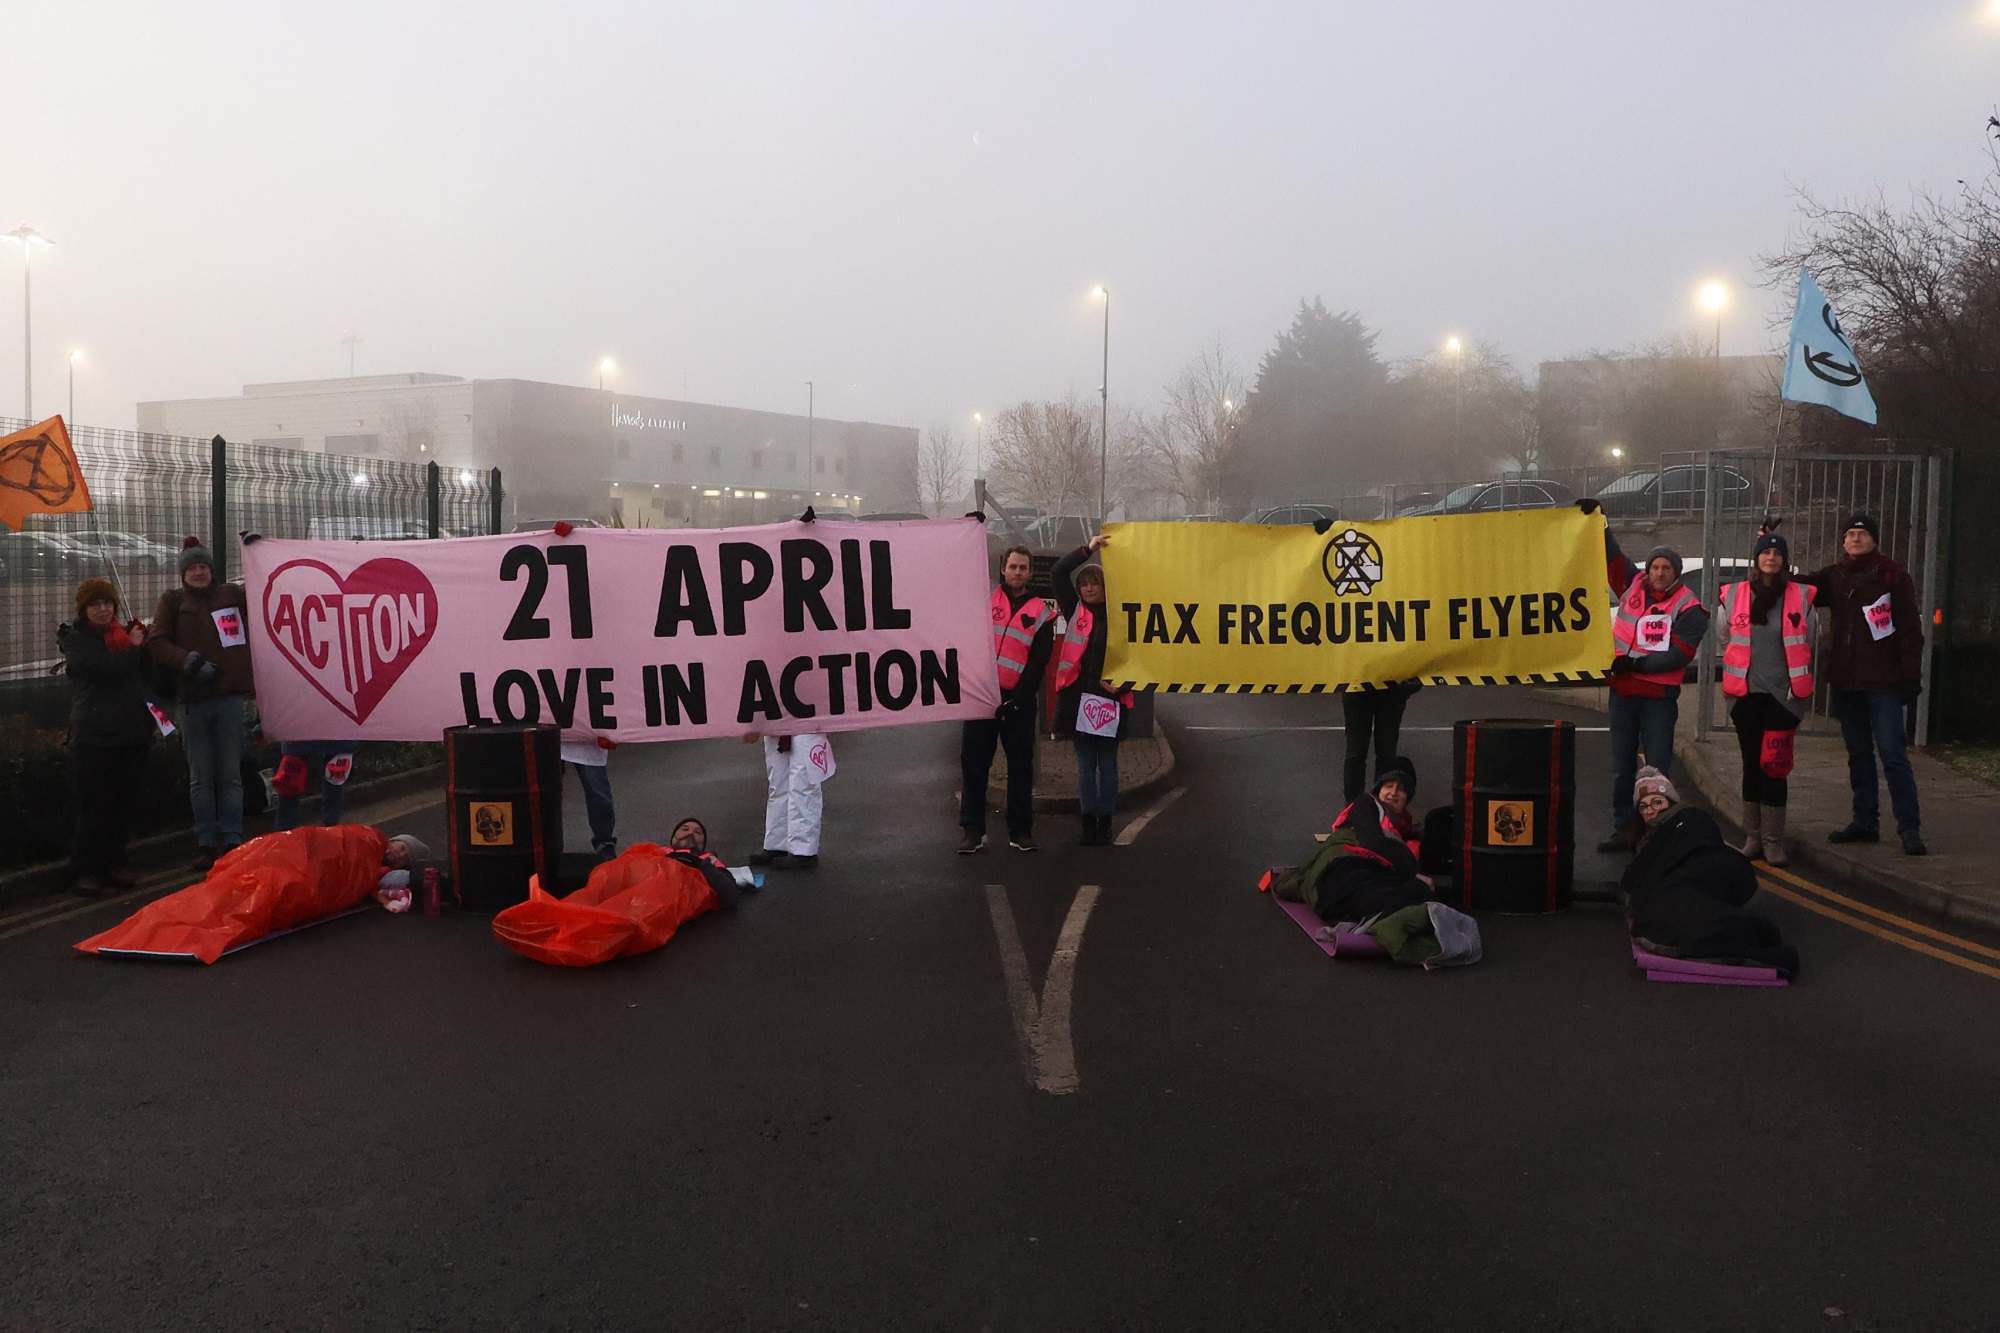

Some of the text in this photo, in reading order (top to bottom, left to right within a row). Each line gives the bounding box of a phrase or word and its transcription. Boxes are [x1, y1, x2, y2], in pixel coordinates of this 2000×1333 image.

[500, 539, 911, 640] 21 APRIL
[1122, 587, 1591, 646] TAX FREQUENT FLYERS
[1646, 620, 1664, 630] FOR
[273, 593, 427, 695] ACTION
[460, 648, 961, 729] LOVE IN ACTION
